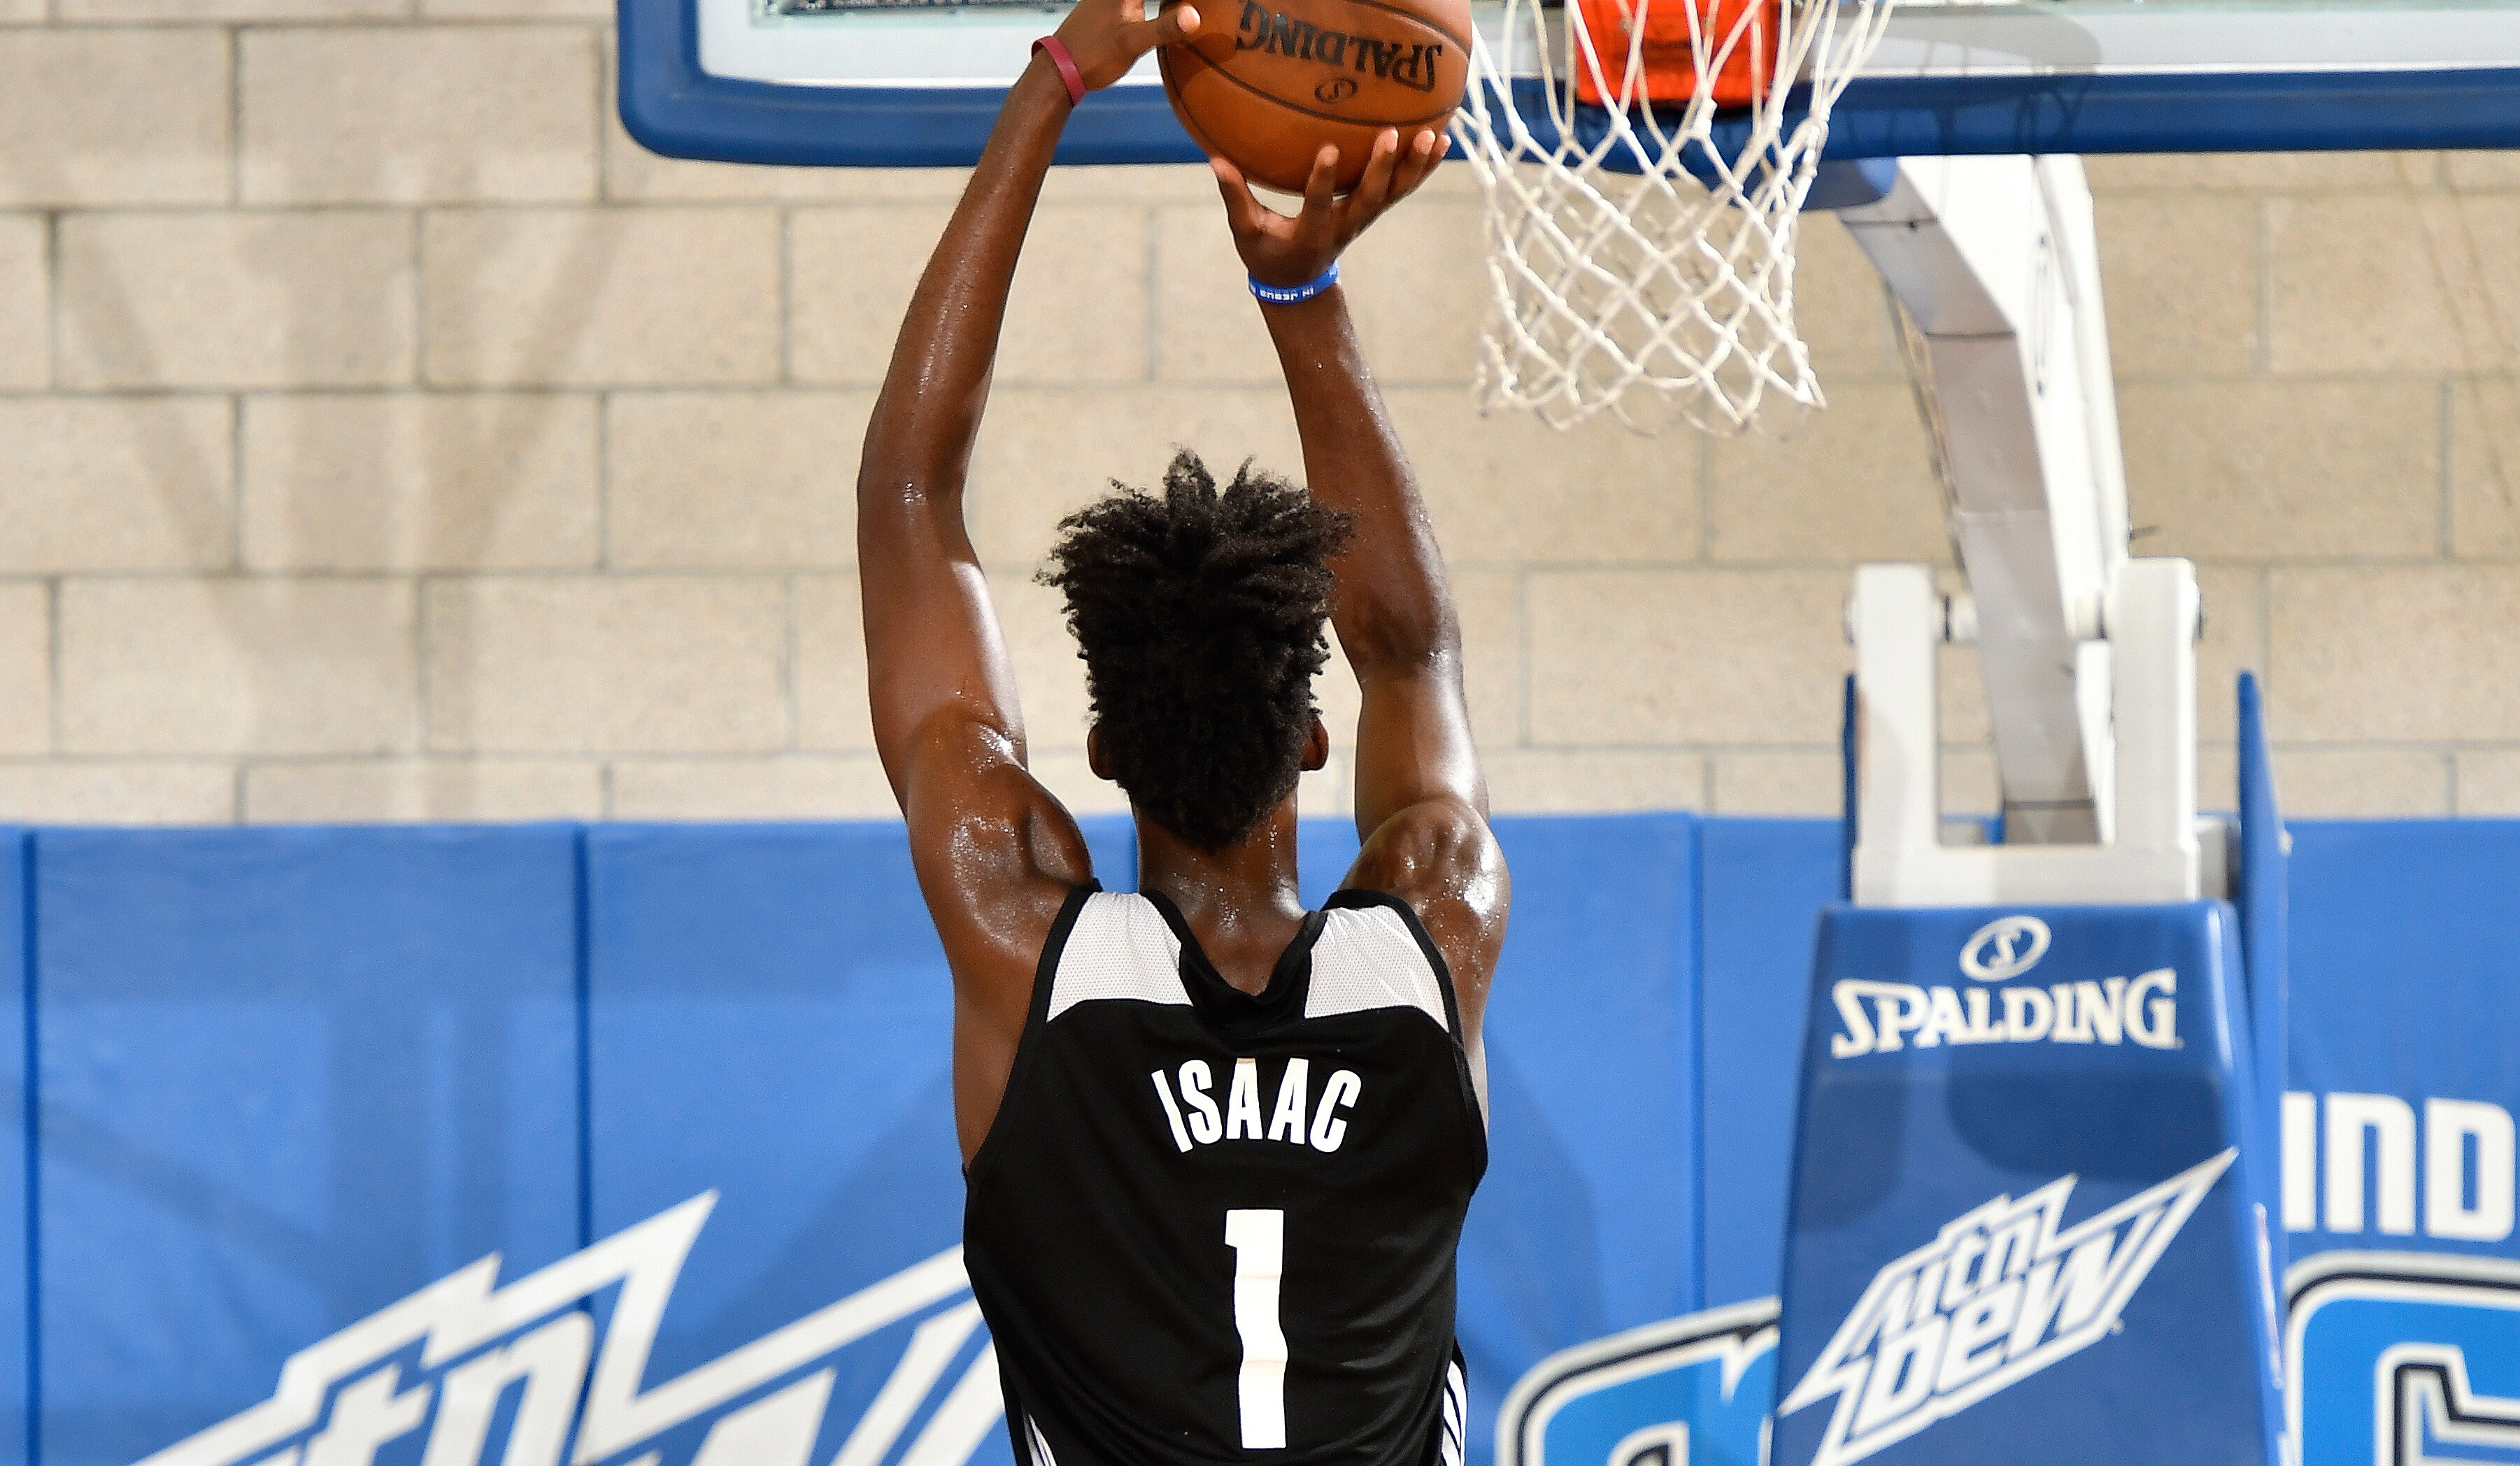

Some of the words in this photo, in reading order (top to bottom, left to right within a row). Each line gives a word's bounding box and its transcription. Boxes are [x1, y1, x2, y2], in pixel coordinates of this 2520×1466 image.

[1235, 1, 1444, 94] SPALDING
[1830, 967, 2178, 1059] SPALDING
[1151, 1057, 1362, 1154] ISAAC
[1224, 1209, 1288, 1450] 1
